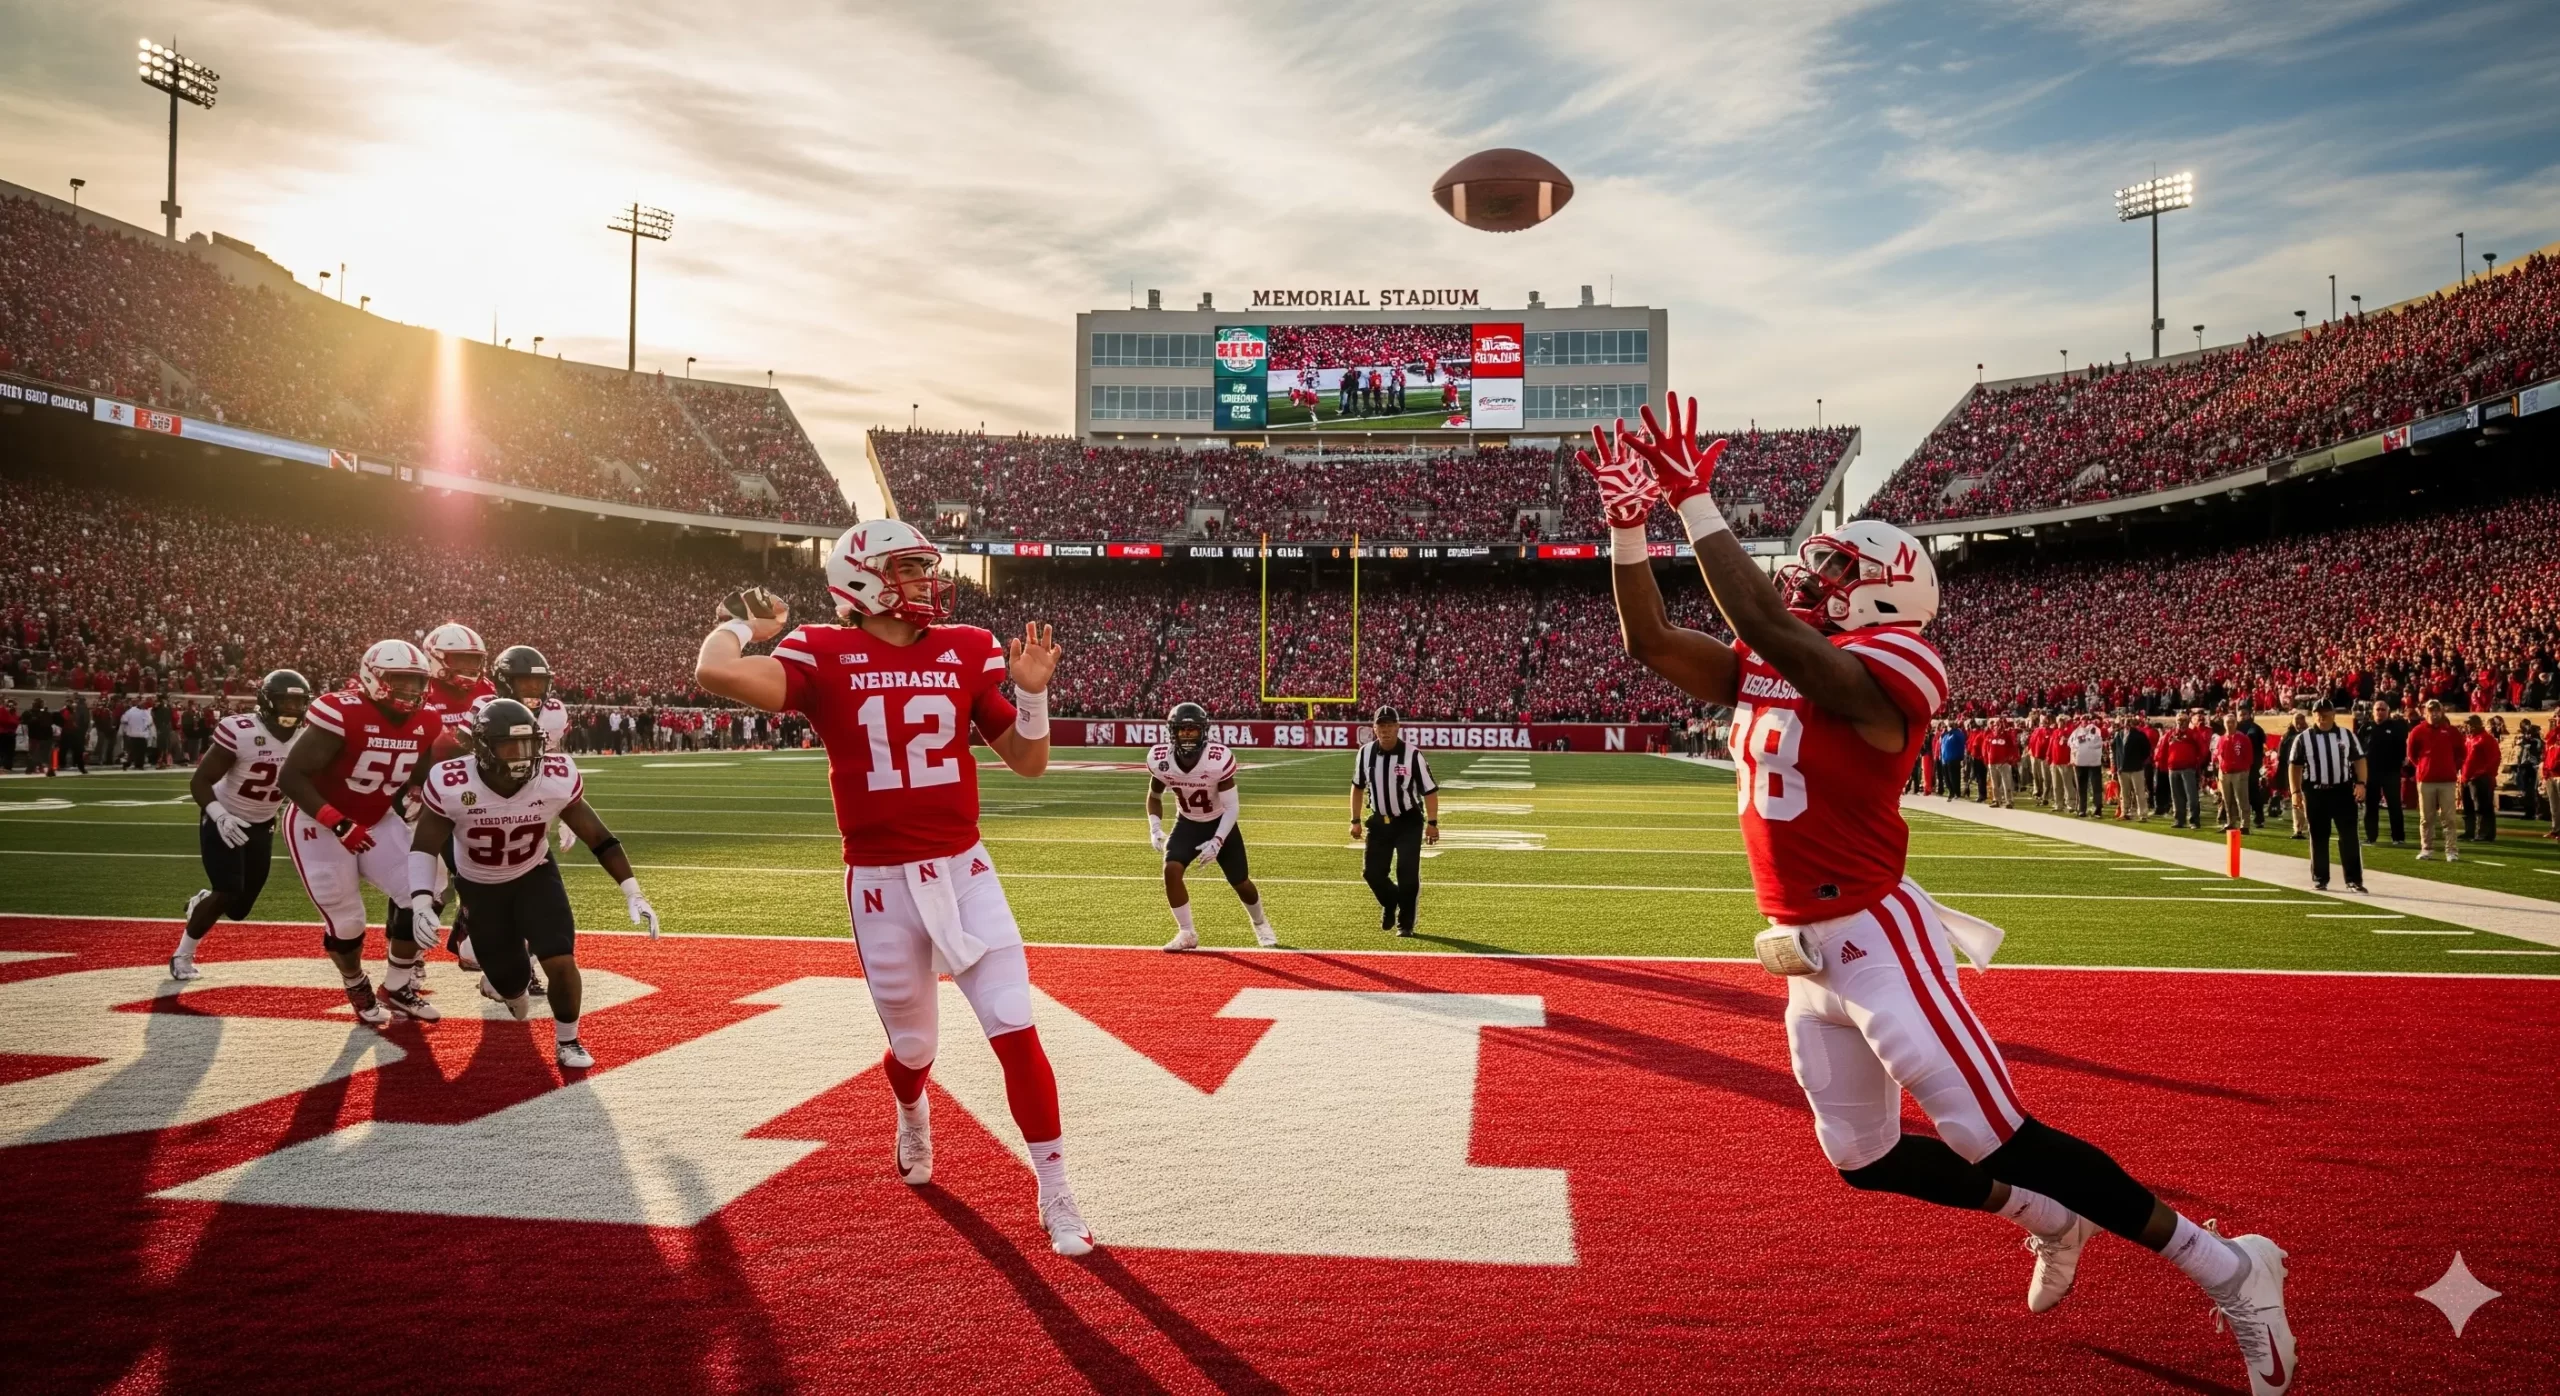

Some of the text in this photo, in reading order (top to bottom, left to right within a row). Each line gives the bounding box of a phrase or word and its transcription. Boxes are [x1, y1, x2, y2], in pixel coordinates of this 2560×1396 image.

[1251, 289, 1479, 306] MEMORIAL STADIUM
[850, 530, 868, 554] N
[1893, 540, 1917, 574] N
[850, 671, 960, 690] NEBRASKA
[858, 694, 960, 791] 12
[1605, 727, 1625, 750] N
[1172, 787, 1213, 814] 14
[303, 827, 318, 841] N
[919, 863, 939, 883] N
[863, 888, 885, 913] N
